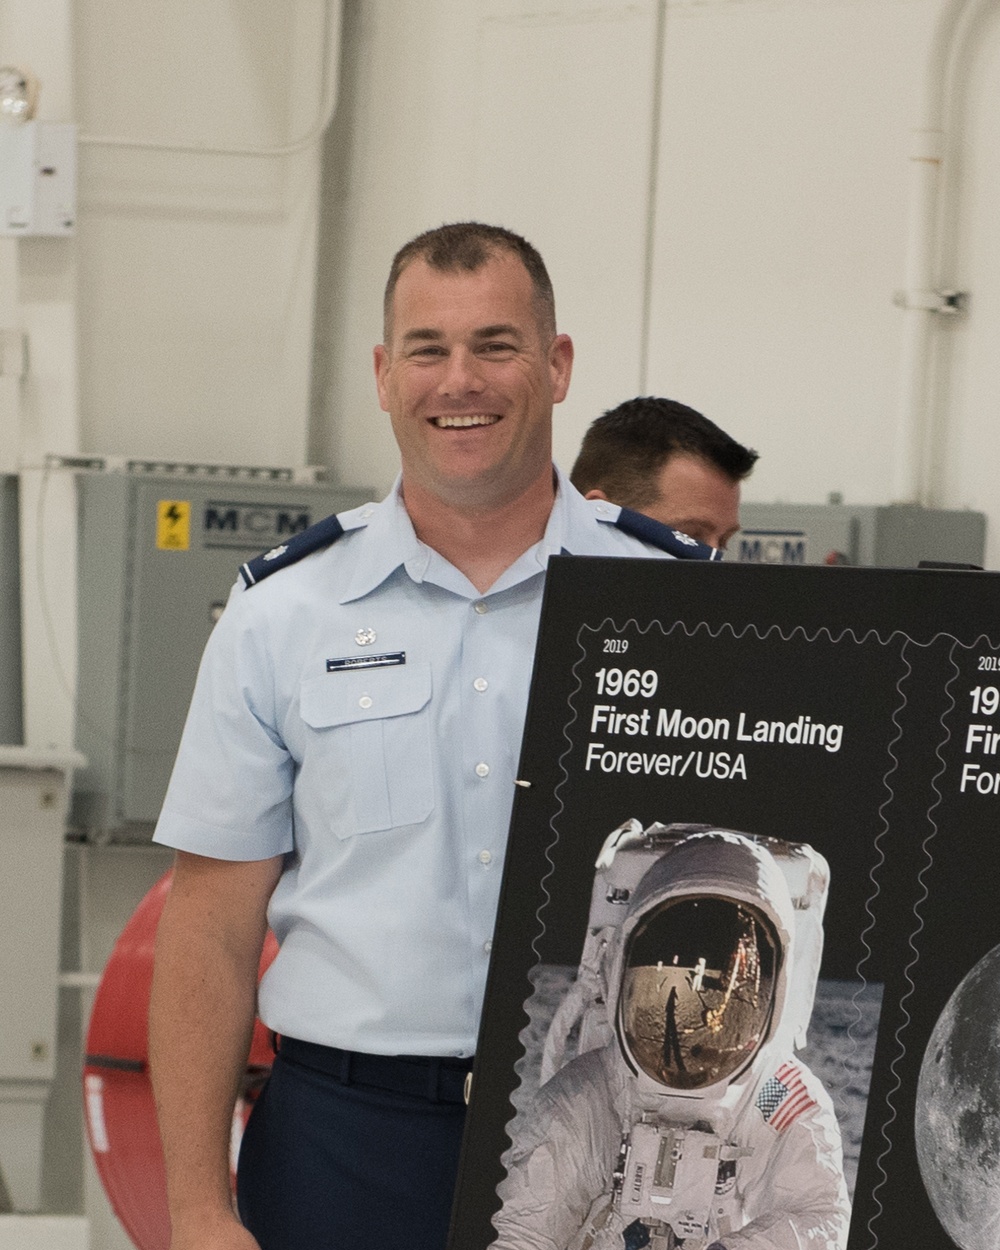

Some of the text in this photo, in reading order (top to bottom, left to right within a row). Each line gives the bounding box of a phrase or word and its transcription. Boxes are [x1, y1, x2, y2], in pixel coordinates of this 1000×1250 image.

[204, 508, 309, 533] MCM
[602, 639, 629, 654] 2019
[595, 667, 659, 698] 1969
[590, 705, 844, 753] First Moon Landing
[585, 743, 748, 781] Forever/USA
